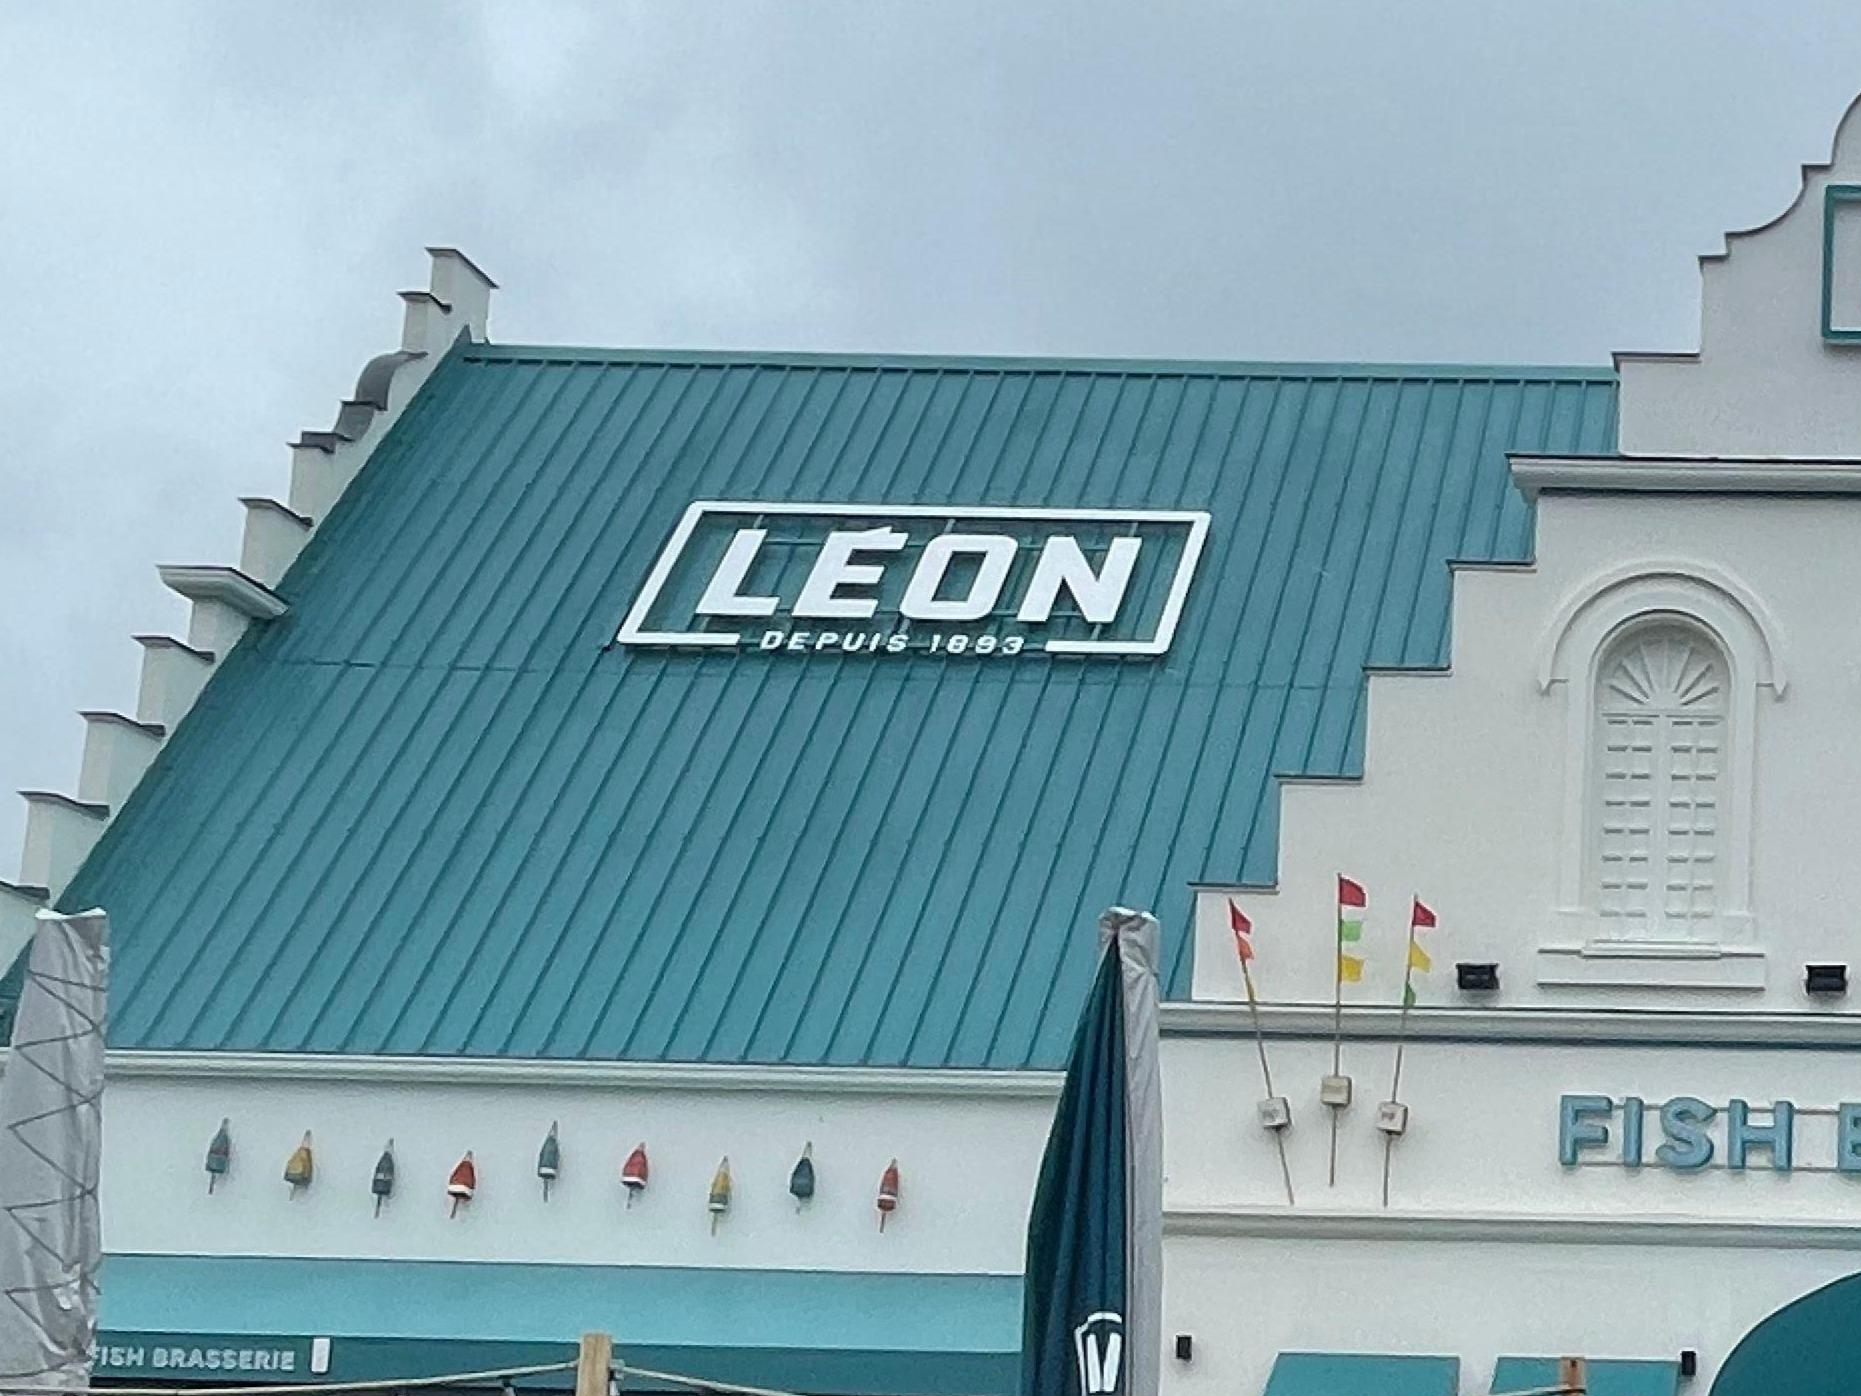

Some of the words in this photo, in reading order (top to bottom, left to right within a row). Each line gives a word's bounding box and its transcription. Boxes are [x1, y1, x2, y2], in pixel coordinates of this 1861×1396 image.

[759, 629, 910, 653] DEPUIS
[929, 633, 1026, 655] 1893
[1559, 1094, 1794, 1174] FISH
[151, 1347, 296, 1371] BRASSERIE
